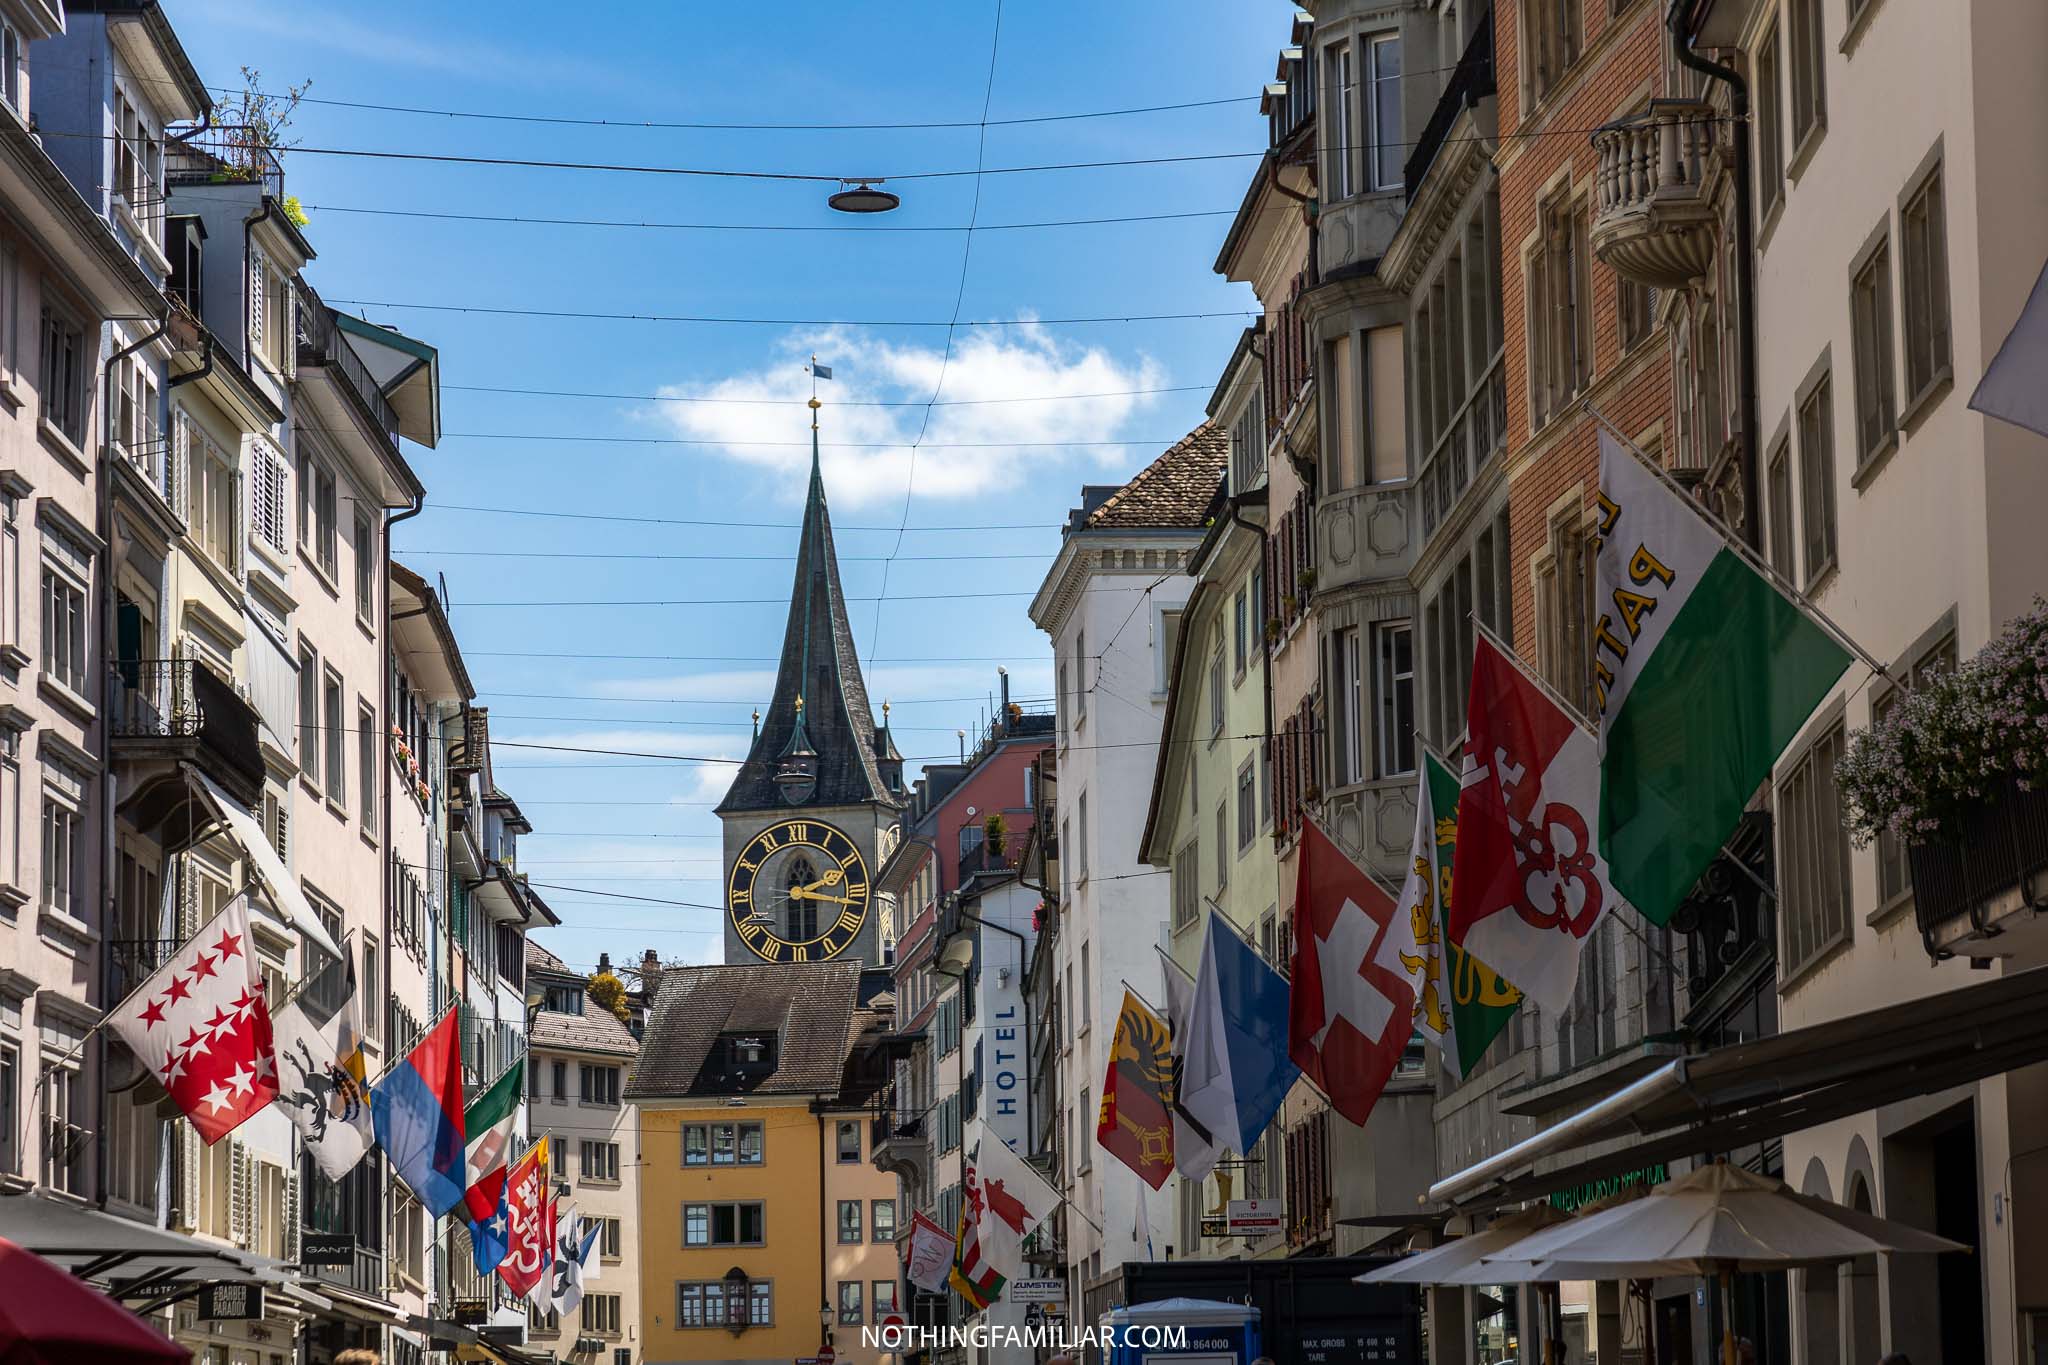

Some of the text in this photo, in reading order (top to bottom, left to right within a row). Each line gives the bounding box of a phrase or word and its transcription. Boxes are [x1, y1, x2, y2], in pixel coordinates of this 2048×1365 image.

[788, 824, 807, 842] XII
[760, 833, 779, 853] XI
[740, 858, 757, 872] X
[841, 852, 858, 868] II
[733, 889, 749, 905] IX
[849, 882, 866, 898] III
[995, 1006, 1017, 1115] HOTEL
[305, 1246, 351, 1254] GANT
[218, 1285, 247, 1301] BARBER
[213, 1301, 247, 1316] PARADOX
[1321, 1338, 1345, 1347] GROSS
